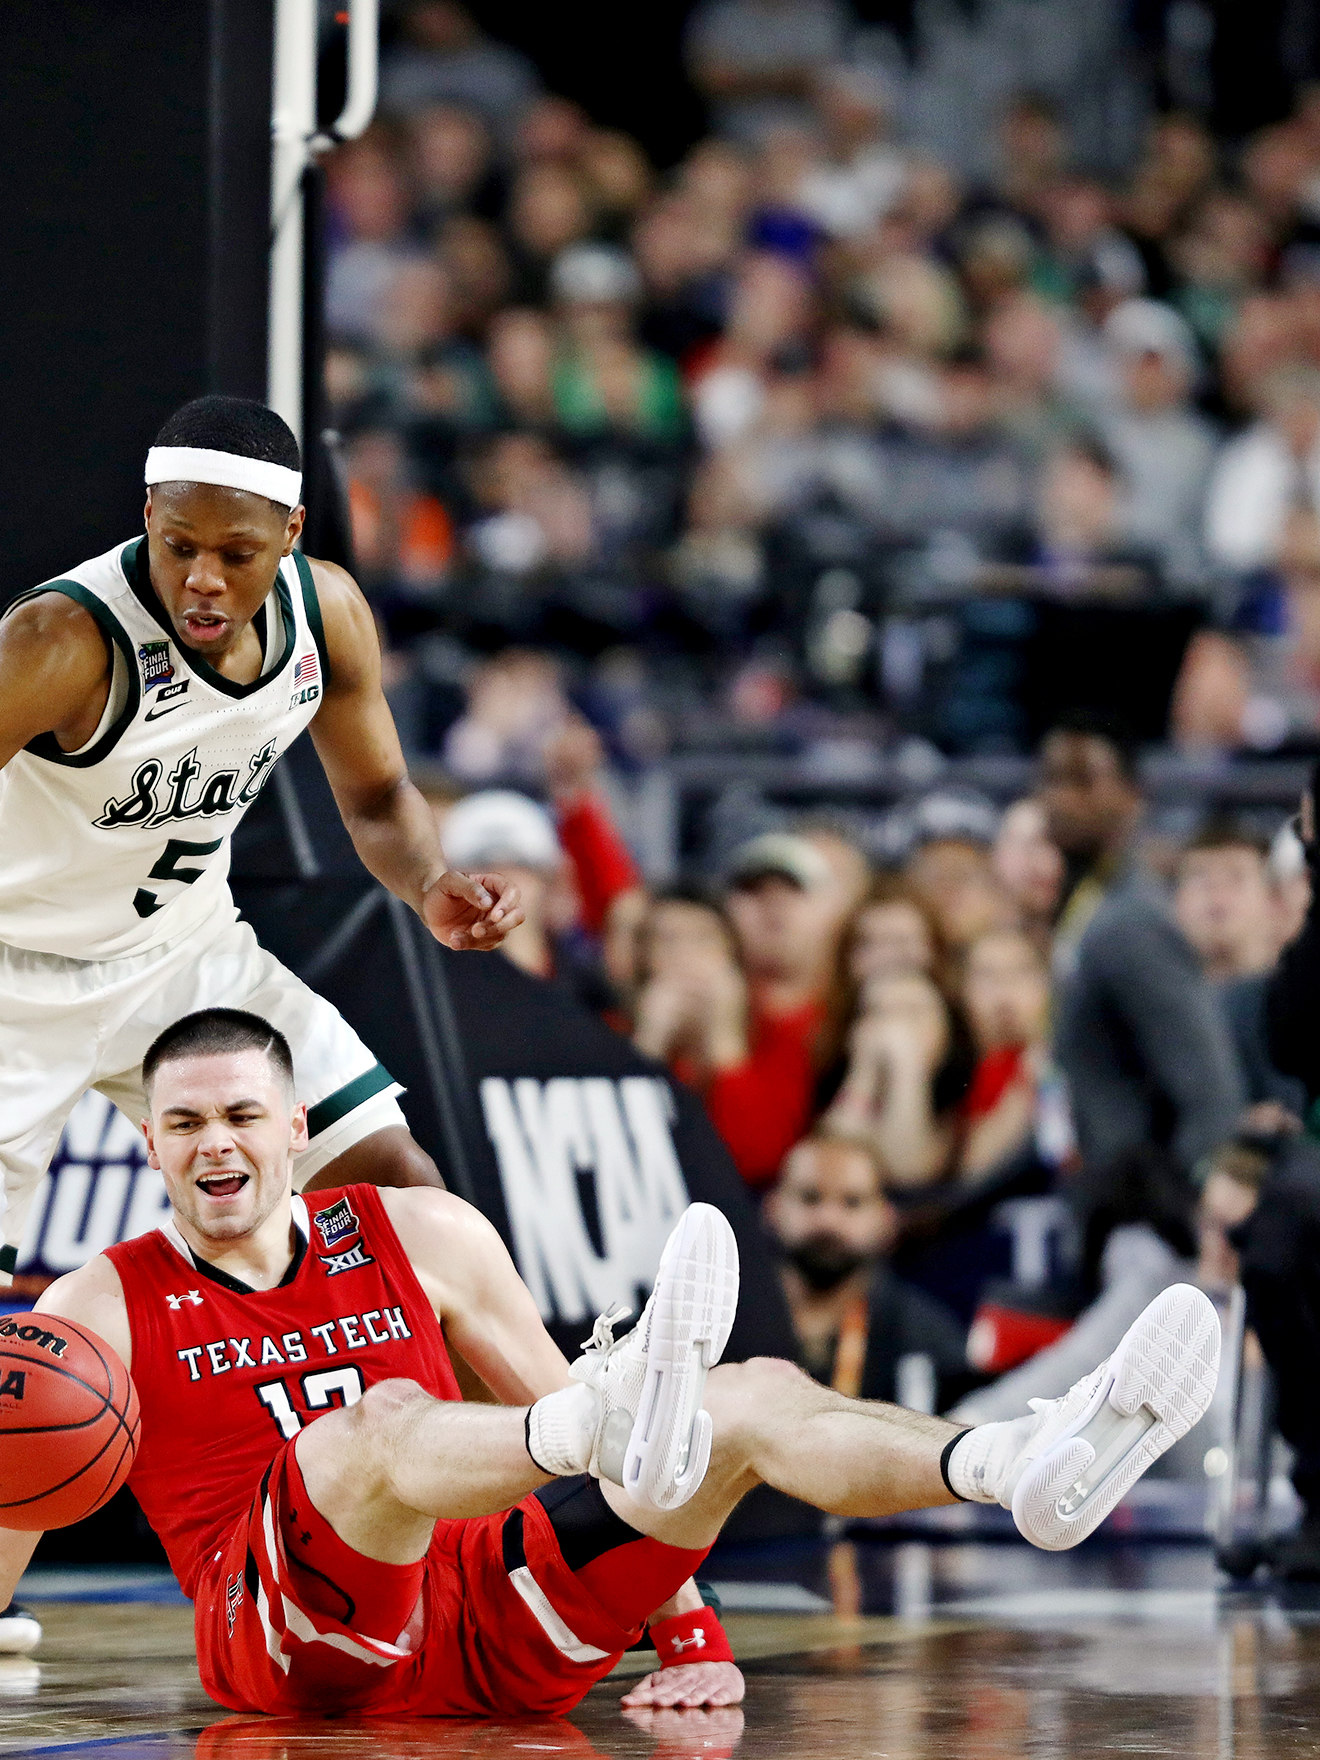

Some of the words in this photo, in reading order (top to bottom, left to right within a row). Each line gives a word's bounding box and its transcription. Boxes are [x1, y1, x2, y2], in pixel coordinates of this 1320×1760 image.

[143, 650, 168, 669] FINAL
[143, 661, 169, 680] FOUR
[91, 737, 288, 830] Stat
[132, 836, 225, 919] 5
[322, 1208, 350, 1228] FINAL
[479, 1075, 690, 1326] NCAA
[324, 1215, 352, 1236] FOUR
[177, 1331, 308, 1382] TEXAS
[311, 1306, 413, 1355] TECH
